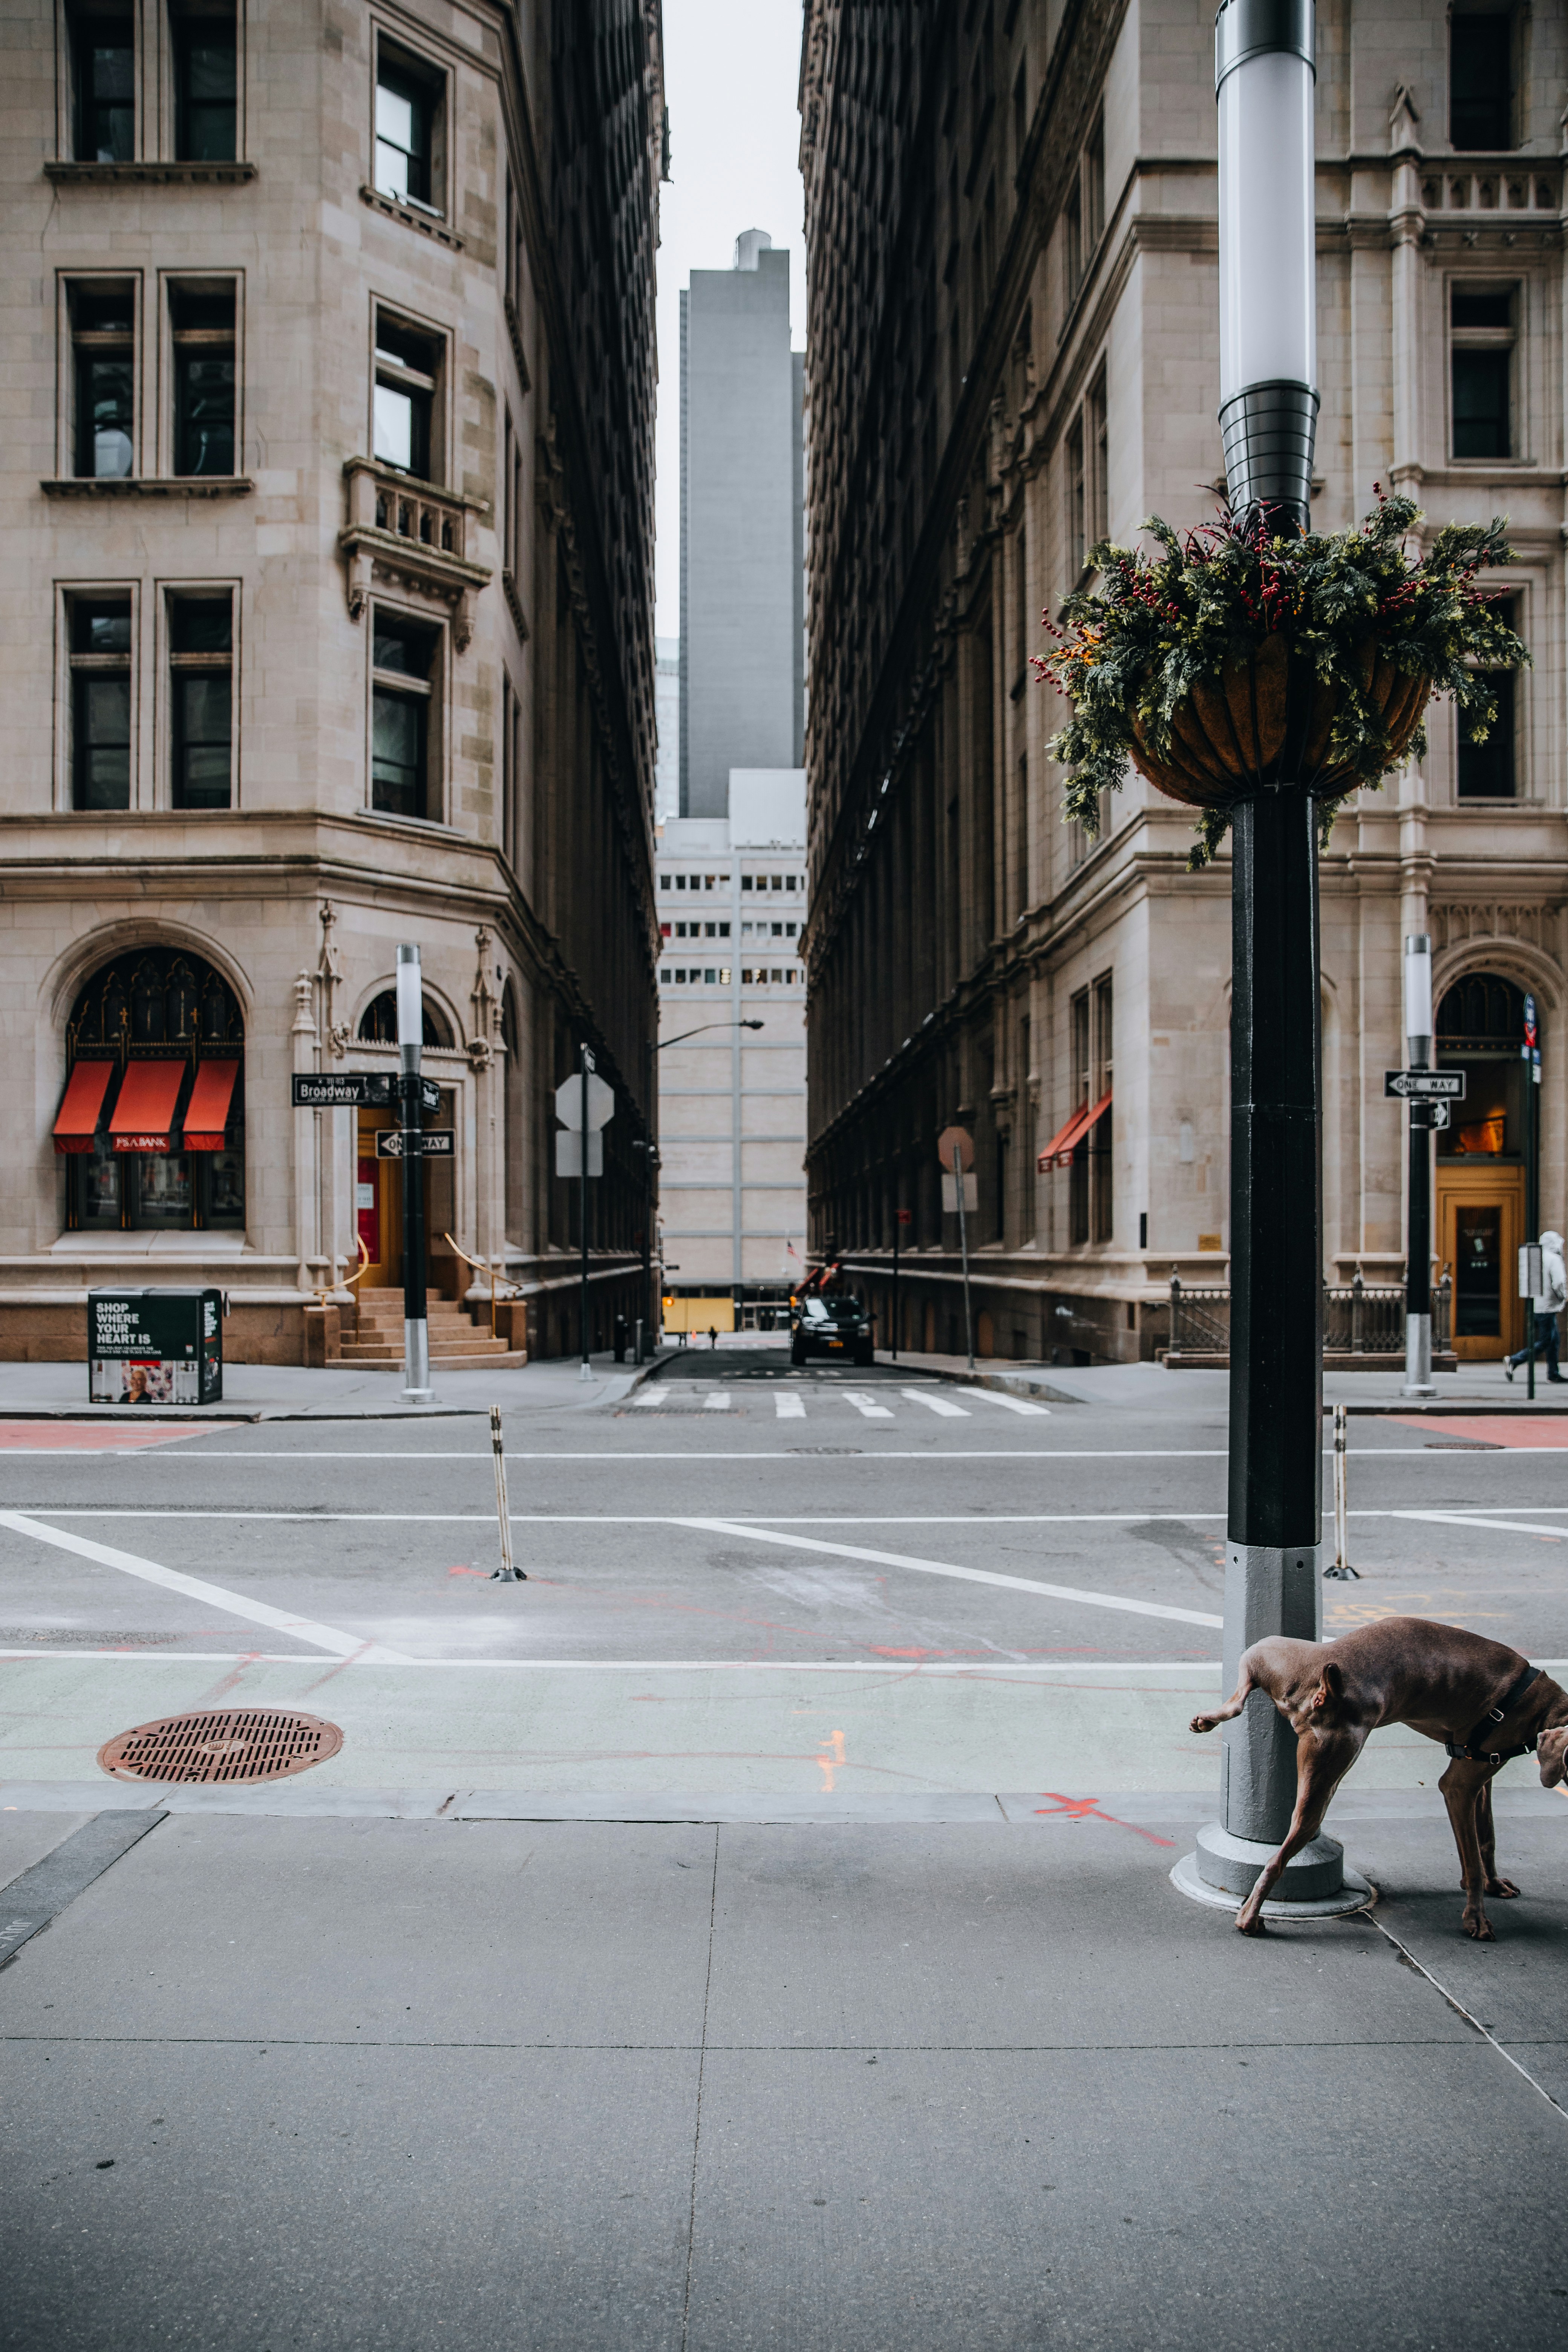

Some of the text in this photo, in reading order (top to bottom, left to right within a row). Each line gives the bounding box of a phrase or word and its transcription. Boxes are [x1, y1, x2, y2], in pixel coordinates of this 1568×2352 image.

[1396, 1078, 1454, 1090] ONE WAY
[301, 1084, 360, 1100] Broadway
[139, 1137, 166, 1147] BANK
[389, 1139, 403, 1150] ON
[96, 1303, 129, 1313] SHOP
[96, 1313, 139, 1324] WHERE
[96, 1323, 129, 1333] YOUR
[97, 1333, 151, 1344] HEART IS
